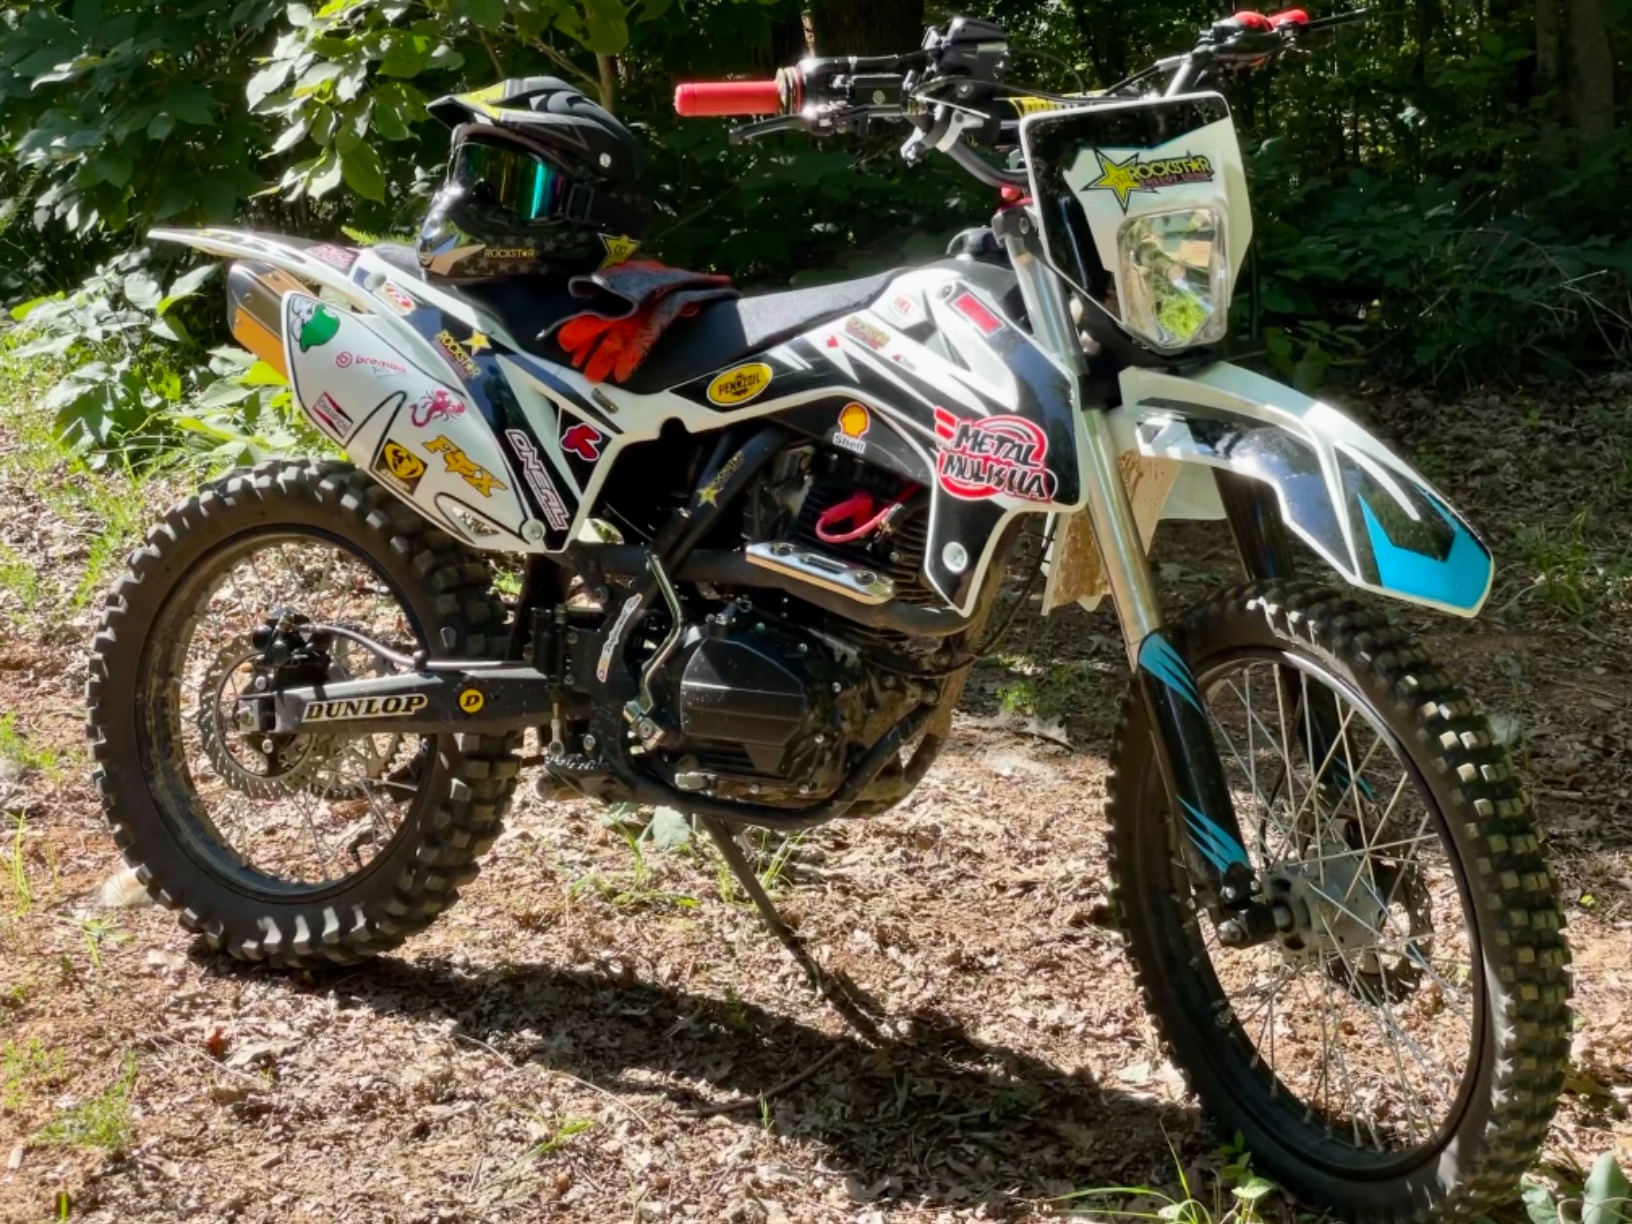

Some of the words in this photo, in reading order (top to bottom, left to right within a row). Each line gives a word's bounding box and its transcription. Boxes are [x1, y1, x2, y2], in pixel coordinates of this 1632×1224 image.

[1128, 157, 1212, 181] ROCKSTAR
[484, 246, 536, 260] ROCKSTAR
[355, 354, 407, 374] brembo
[436, 329, 482, 379] ROCKSTAR
[718, 372, 762, 396] PENNZOIL
[832, 434, 866, 453] Shell
[953, 423, 1044, 467] METAL
[943, 453, 1048, 499] MULISHA
[303, 693, 428, 721] DUNLOP
[463, 694, 481, 708] D
